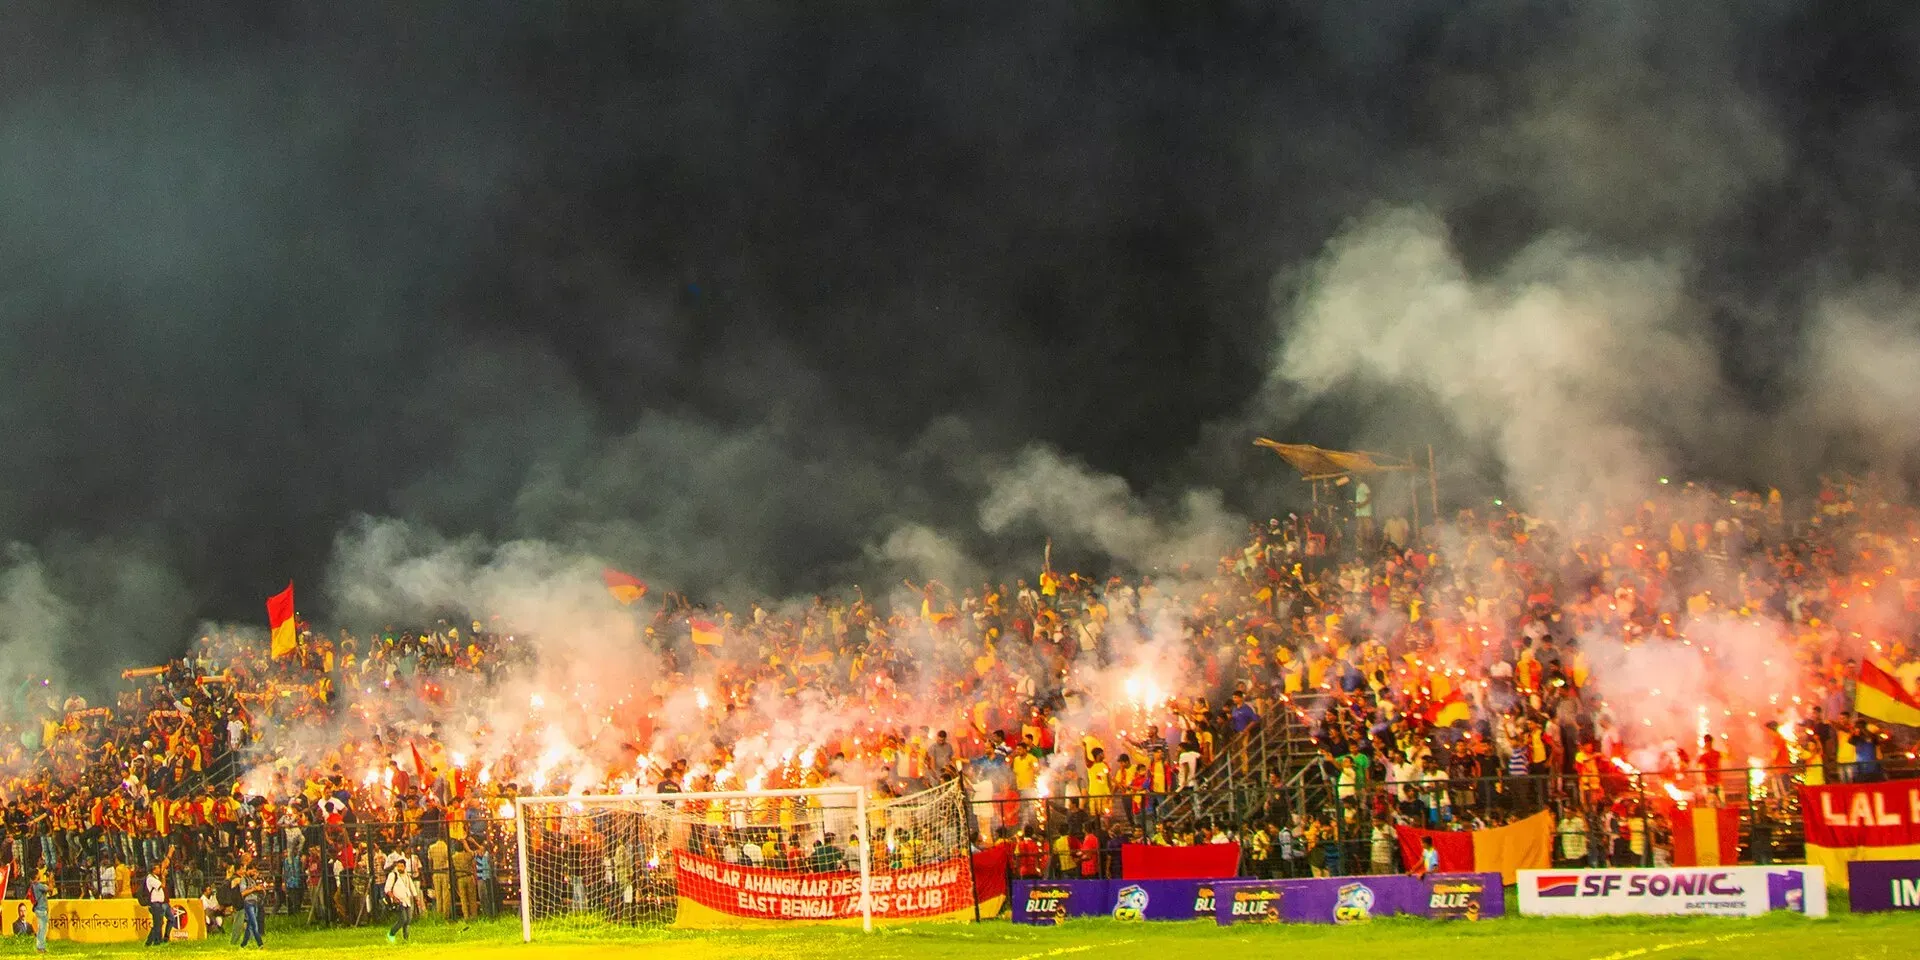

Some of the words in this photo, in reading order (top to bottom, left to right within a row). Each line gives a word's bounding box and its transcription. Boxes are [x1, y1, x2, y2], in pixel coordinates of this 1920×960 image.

[1820, 791, 1901, 826] LAL
[678, 855, 740, 888] BANGLAR
[744, 875, 829, 897] AHANGKAAR
[1582, 874, 1622, 896] SF
[1628, 872, 1745, 896] SONIC
[737, 891, 777, 914] EAST
[781, 899, 836, 917] BENGAL
[1026, 899, 1060, 912] BLUE
[1232, 900, 1269, 915] BLUE
[1428, 894, 1470, 908] BLUE
[1685, 901, 1746, 910] BATTERIES
